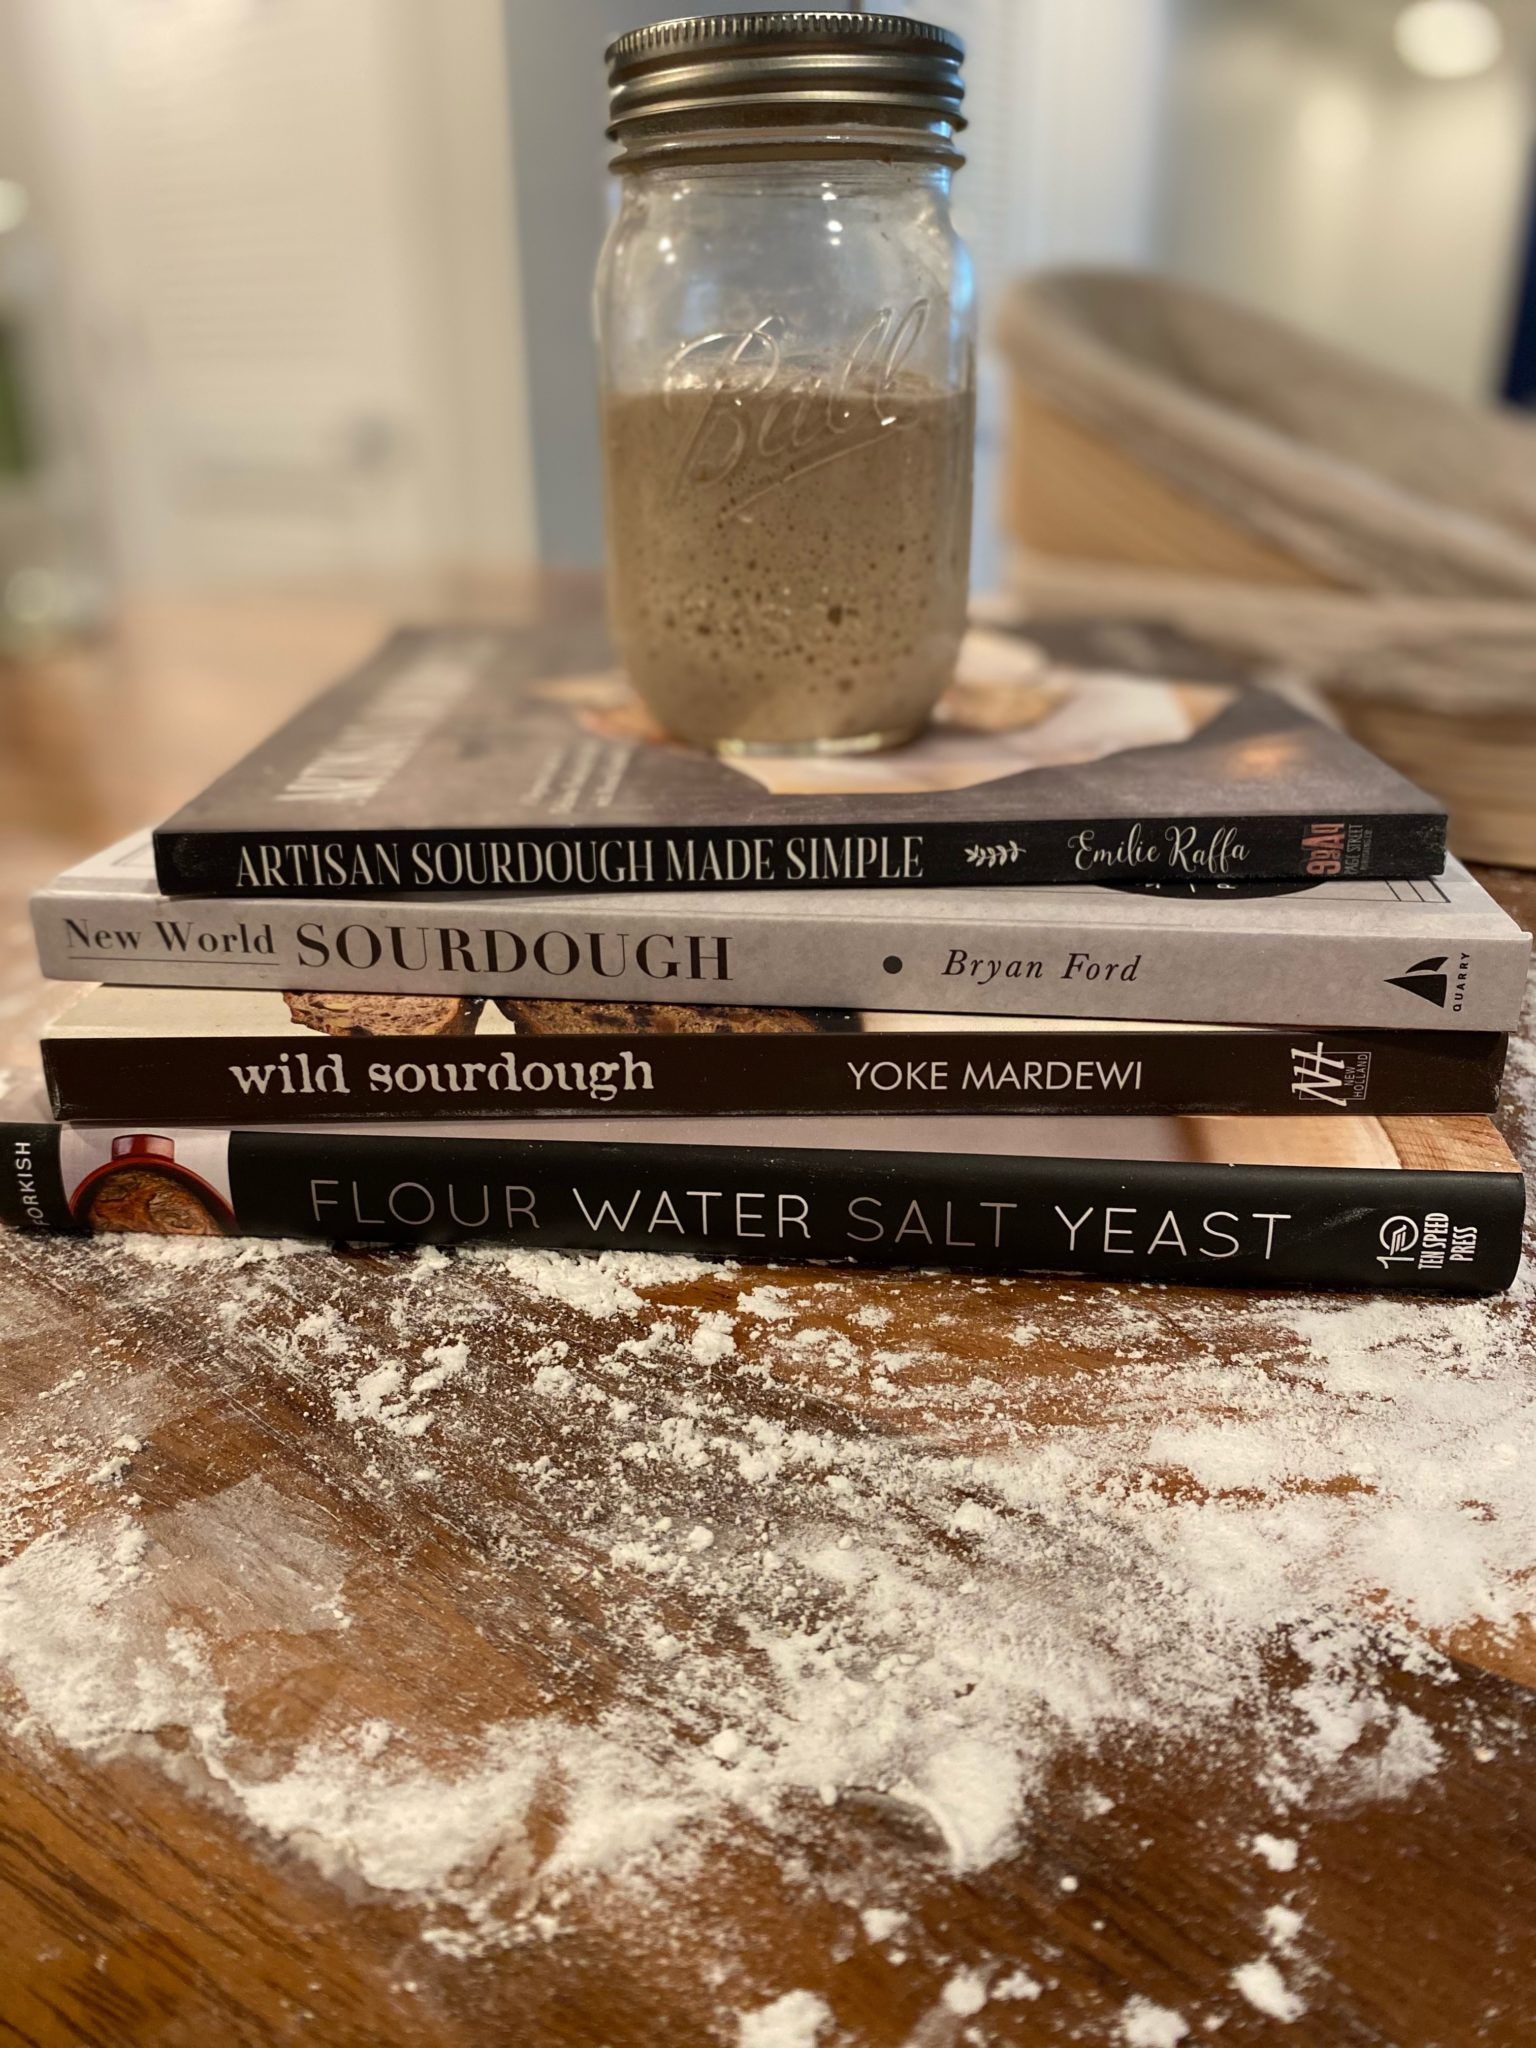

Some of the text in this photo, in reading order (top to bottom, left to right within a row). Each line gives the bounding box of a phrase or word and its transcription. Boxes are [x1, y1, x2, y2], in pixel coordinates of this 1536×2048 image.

[664, 298, 930, 500] Ball
[236, 835, 925, 888] ARTISAN SOURDOUGH MADE SIMPLE
[1067, 823, 1250, 874] Emilie Raffa
[63, 918, 735, 981] New World SOURDOUGH
[941, 949, 1143, 986] Bryan Ford
[1452, 952, 1470, 1012] QUARRY
[228, 1050, 655, 1101] wild sourdough
[847, 1061, 1142, 1090] YOKE MARDEWI
[1343, 1066, 1356, 1086] NEW
[1353, 1053, 1368, 1098] HOLLAND
[14, 1142, 50, 1226] FORKISH
[310, 1179, 1292, 1260] FLOUR WATER SALT YEAST
[1418, 1212, 1450, 1270] TEN SPEED
[1449, 1226, 1478, 1261] PRESS
